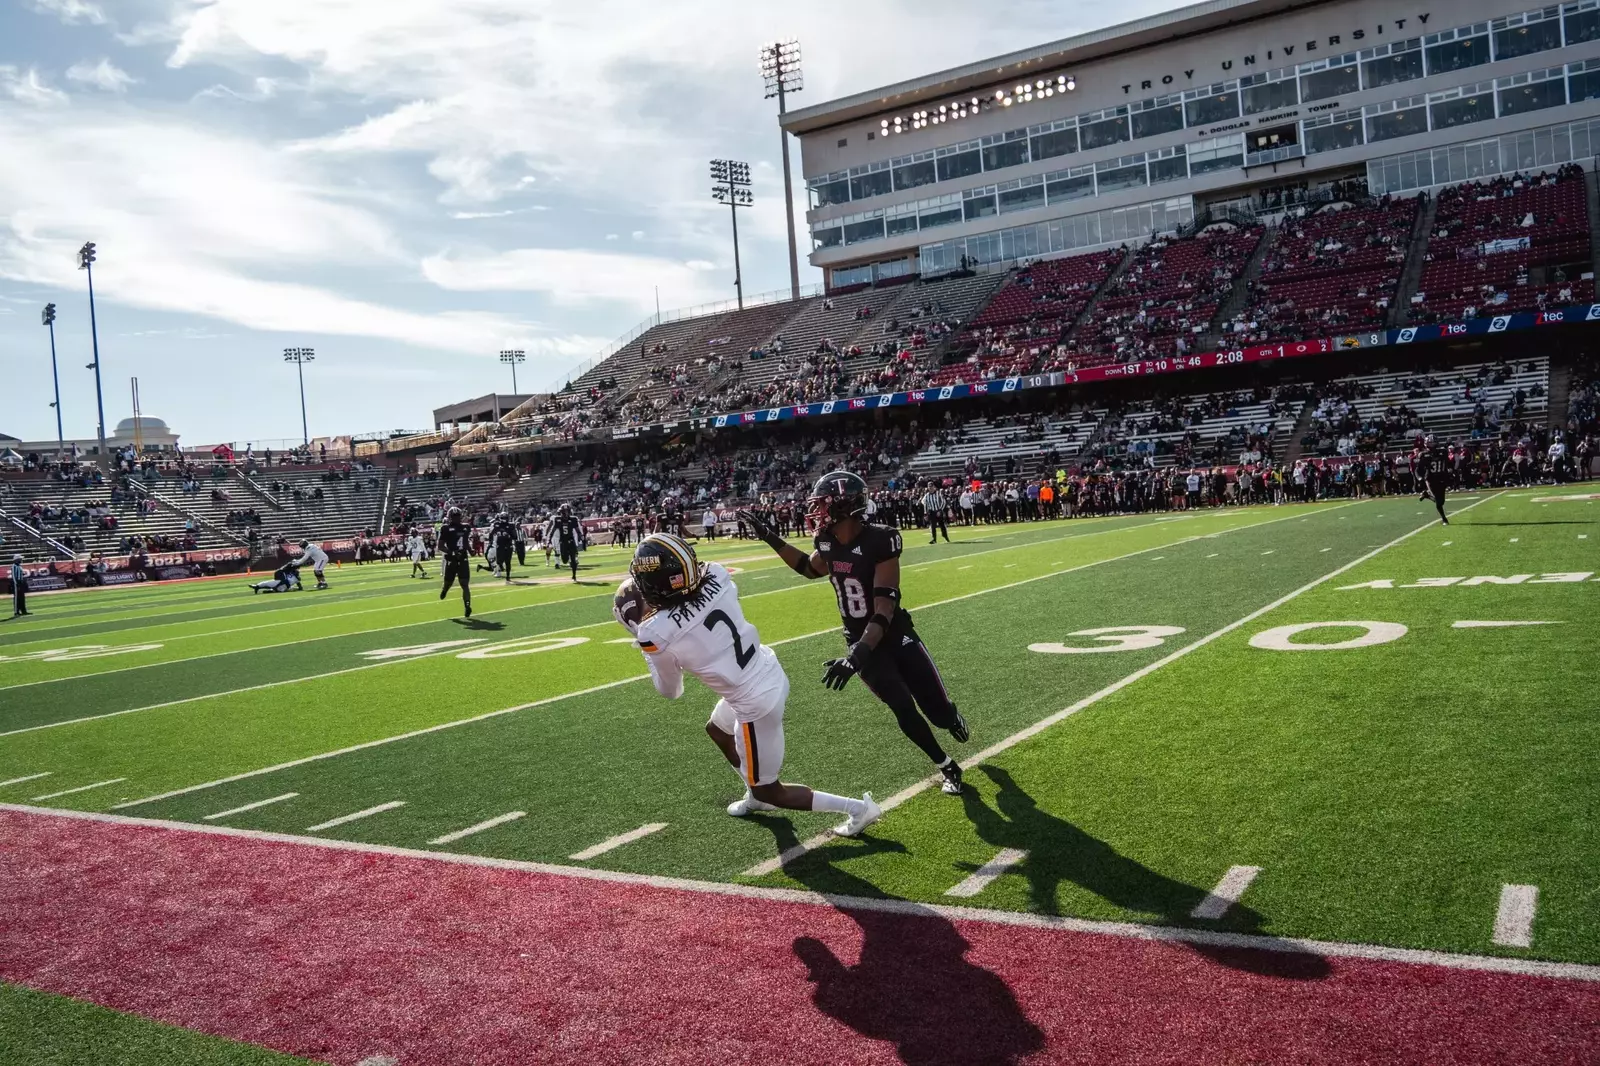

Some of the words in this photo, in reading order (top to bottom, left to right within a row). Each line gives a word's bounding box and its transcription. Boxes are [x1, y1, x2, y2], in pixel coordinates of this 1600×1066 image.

[1121, 69, 1195, 94] TROY
[1221, 12, 1431, 71] UNIVERSITY
[1210, 121, 1250, 134] DOUGLAS
[1258, 111, 1298, 123] HAWKINS
[1308, 102, 1340, 113] TOWER
[1370, 334, 1378, 345] 8
[1277, 346, 1284, 357] 1
[1188, 356, 1201, 367] 46
[1216, 351, 1243, 365] 2:08
[1105, 368, 1122, 376] DOWN
[1122, 364, 1140, 375] 1ST
[1155, 360, 1167, 371] 10
[1029, 376, 1042, 387] 10
[1073, 374, 1079, 382] 3
[456, 537, 464, 550] 4
[890, 535, 902, 553] 18
[144, 556, 184, 567] 2022
[832, 561, 853, 573] TROY
[831, 576, 868, 618] 18
[703, 609, 756, 670] 2
